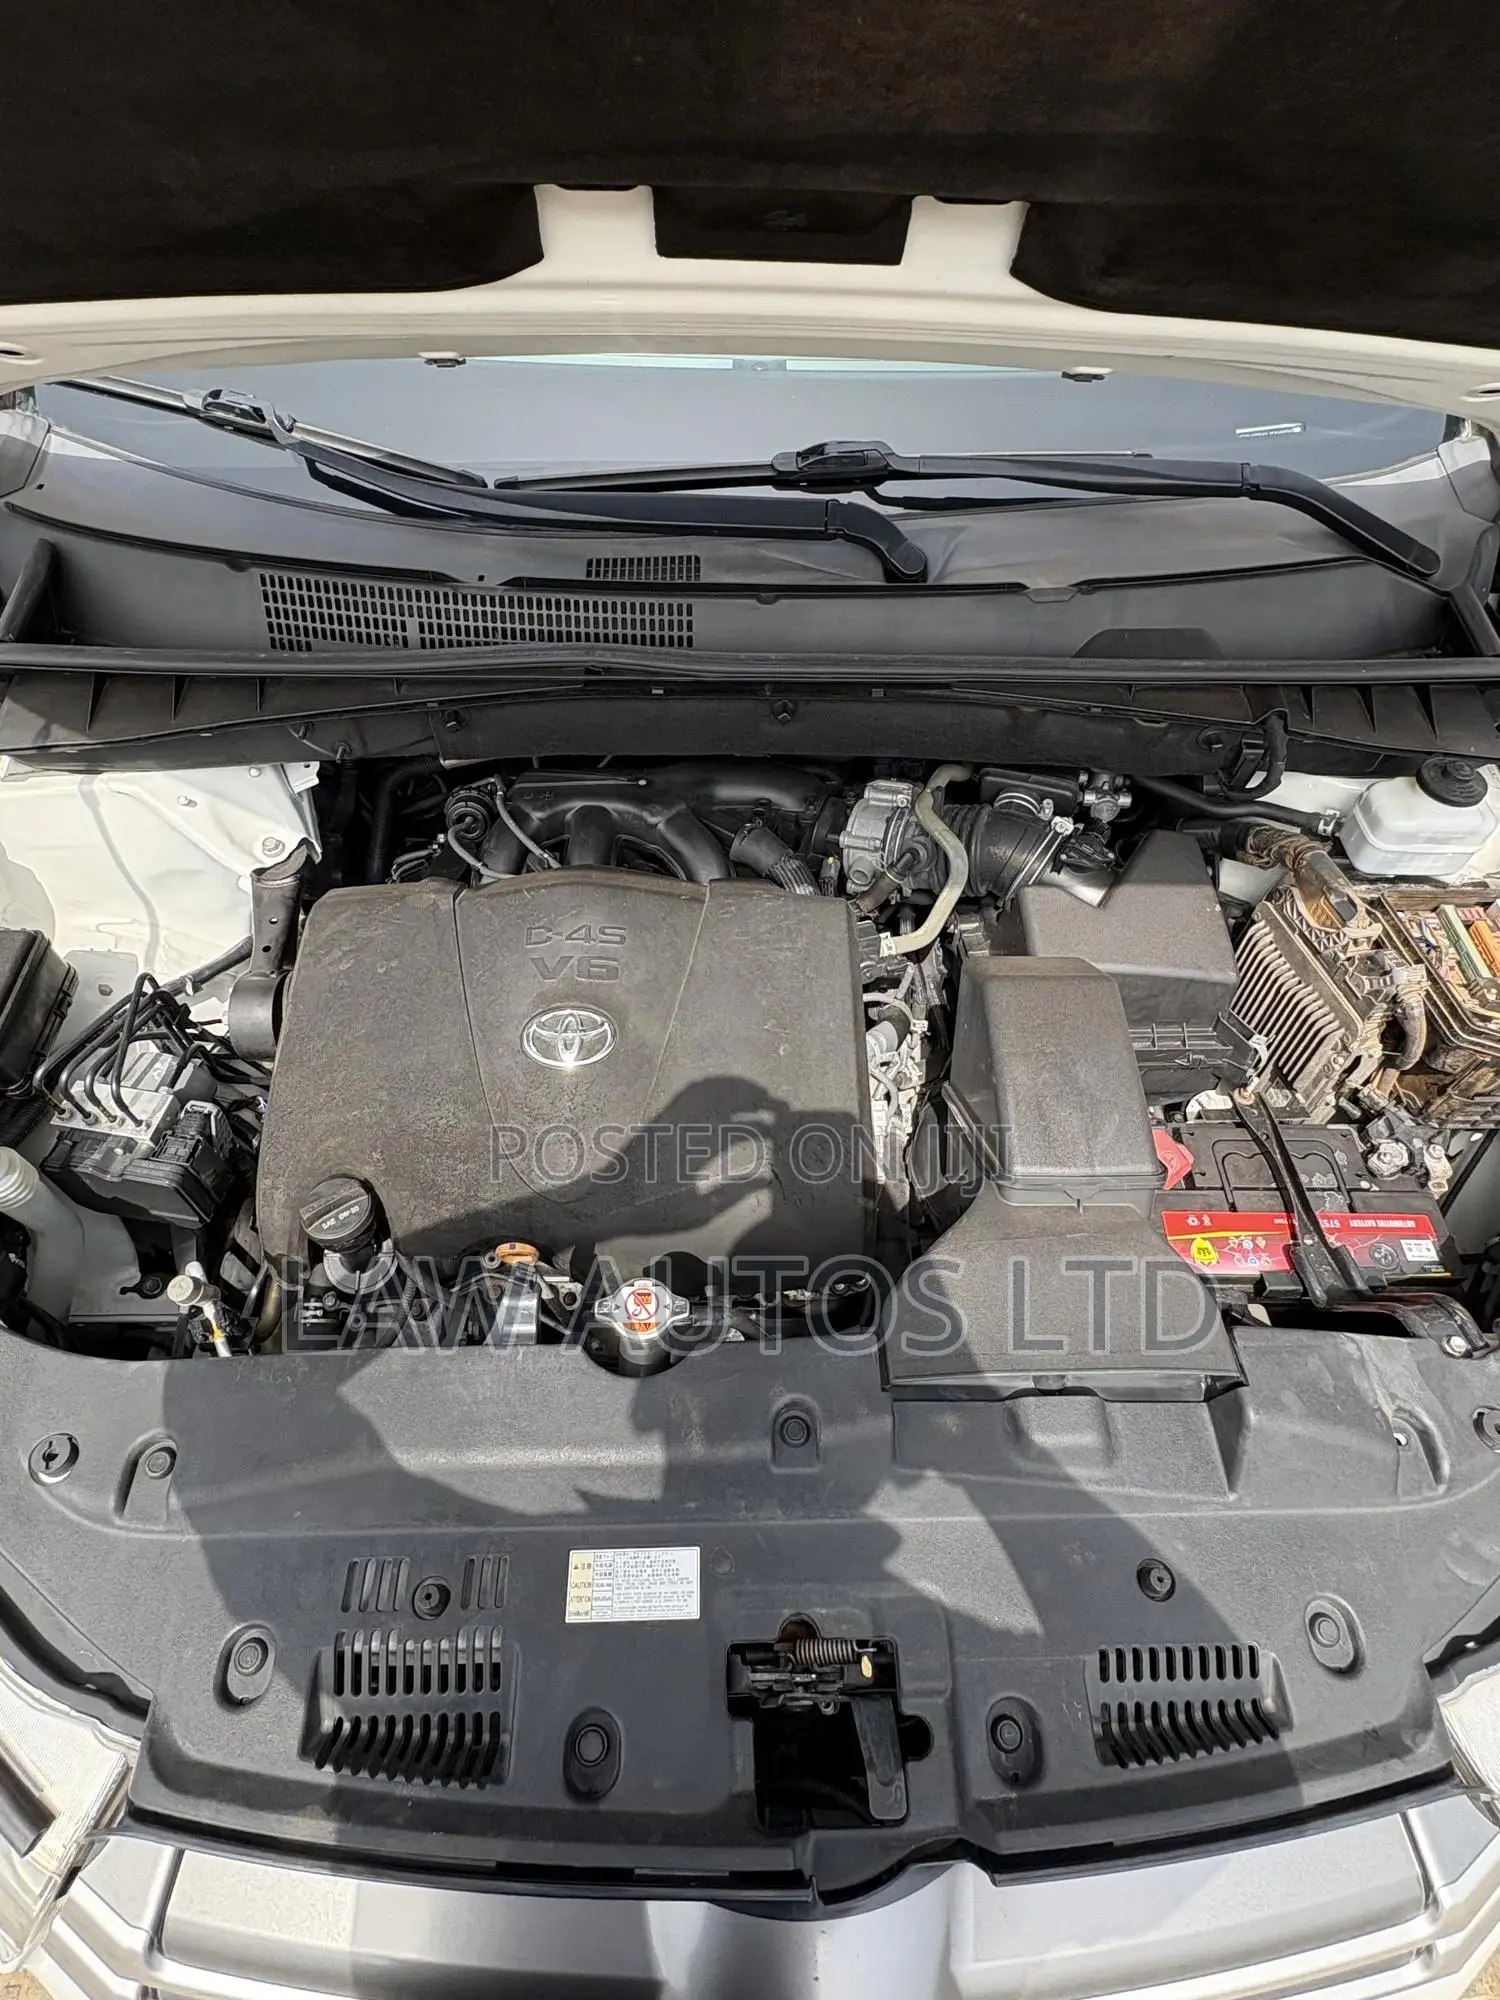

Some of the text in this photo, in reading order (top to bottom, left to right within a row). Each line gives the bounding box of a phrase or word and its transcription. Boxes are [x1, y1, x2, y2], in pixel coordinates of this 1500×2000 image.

[525, 924, 627, 948] D-4S
[530, 955, 619, 983] V6
[321, 1205, 360, 1230] SAE 0W-20
